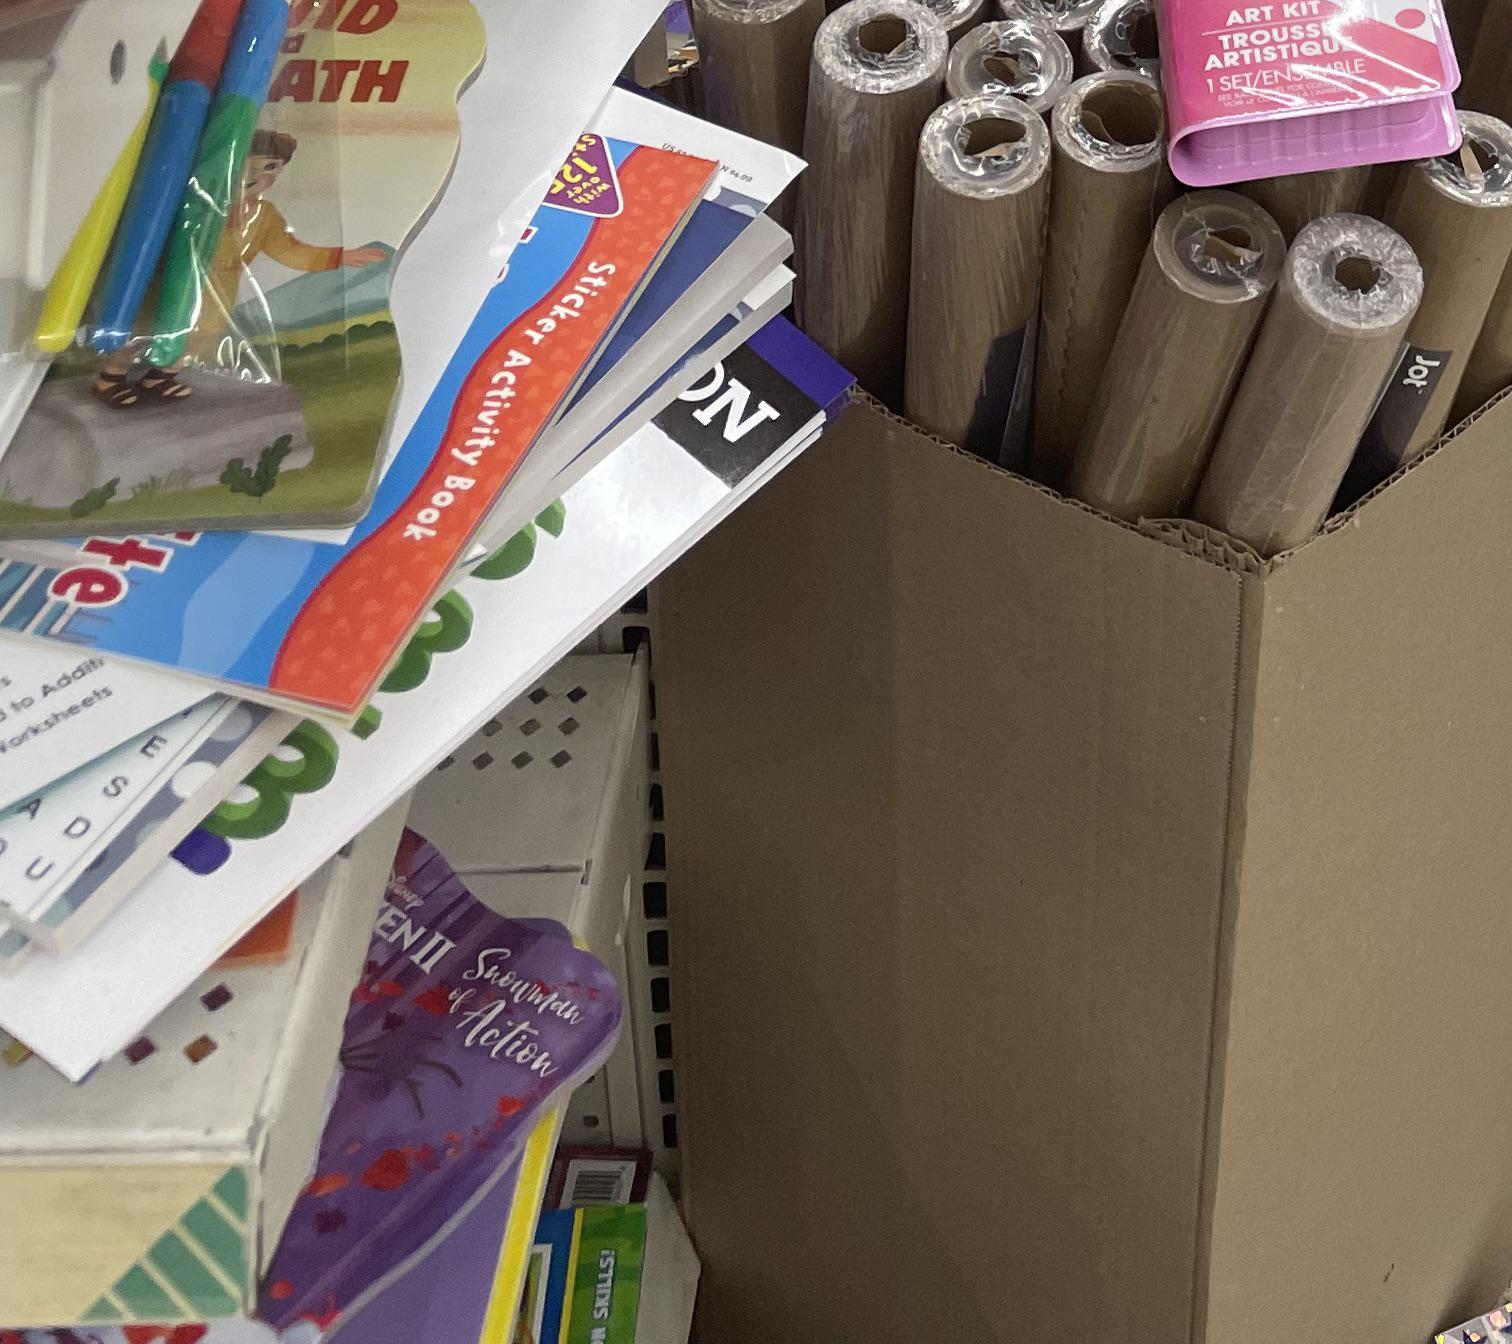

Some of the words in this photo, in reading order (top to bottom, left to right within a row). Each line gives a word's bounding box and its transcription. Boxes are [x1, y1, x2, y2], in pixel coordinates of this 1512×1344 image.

[1225, 6, 1274, 26] ART
[1282, 0, 1321, 18] KIT
[521, 260, 618, 346] Sticker
[1403, 354, 1441, 389] Jot
[450, 348, 532, 466] Activity
[402, 473, 477, 541] Book
[409, 930, 457, 975] II
[462, 947, 585, 1025] Snowman
[449, 986, 477, 1014] of
[455, 999, 561, 1078] Action
[592, 1249, 616, 1320] SKILLS!
